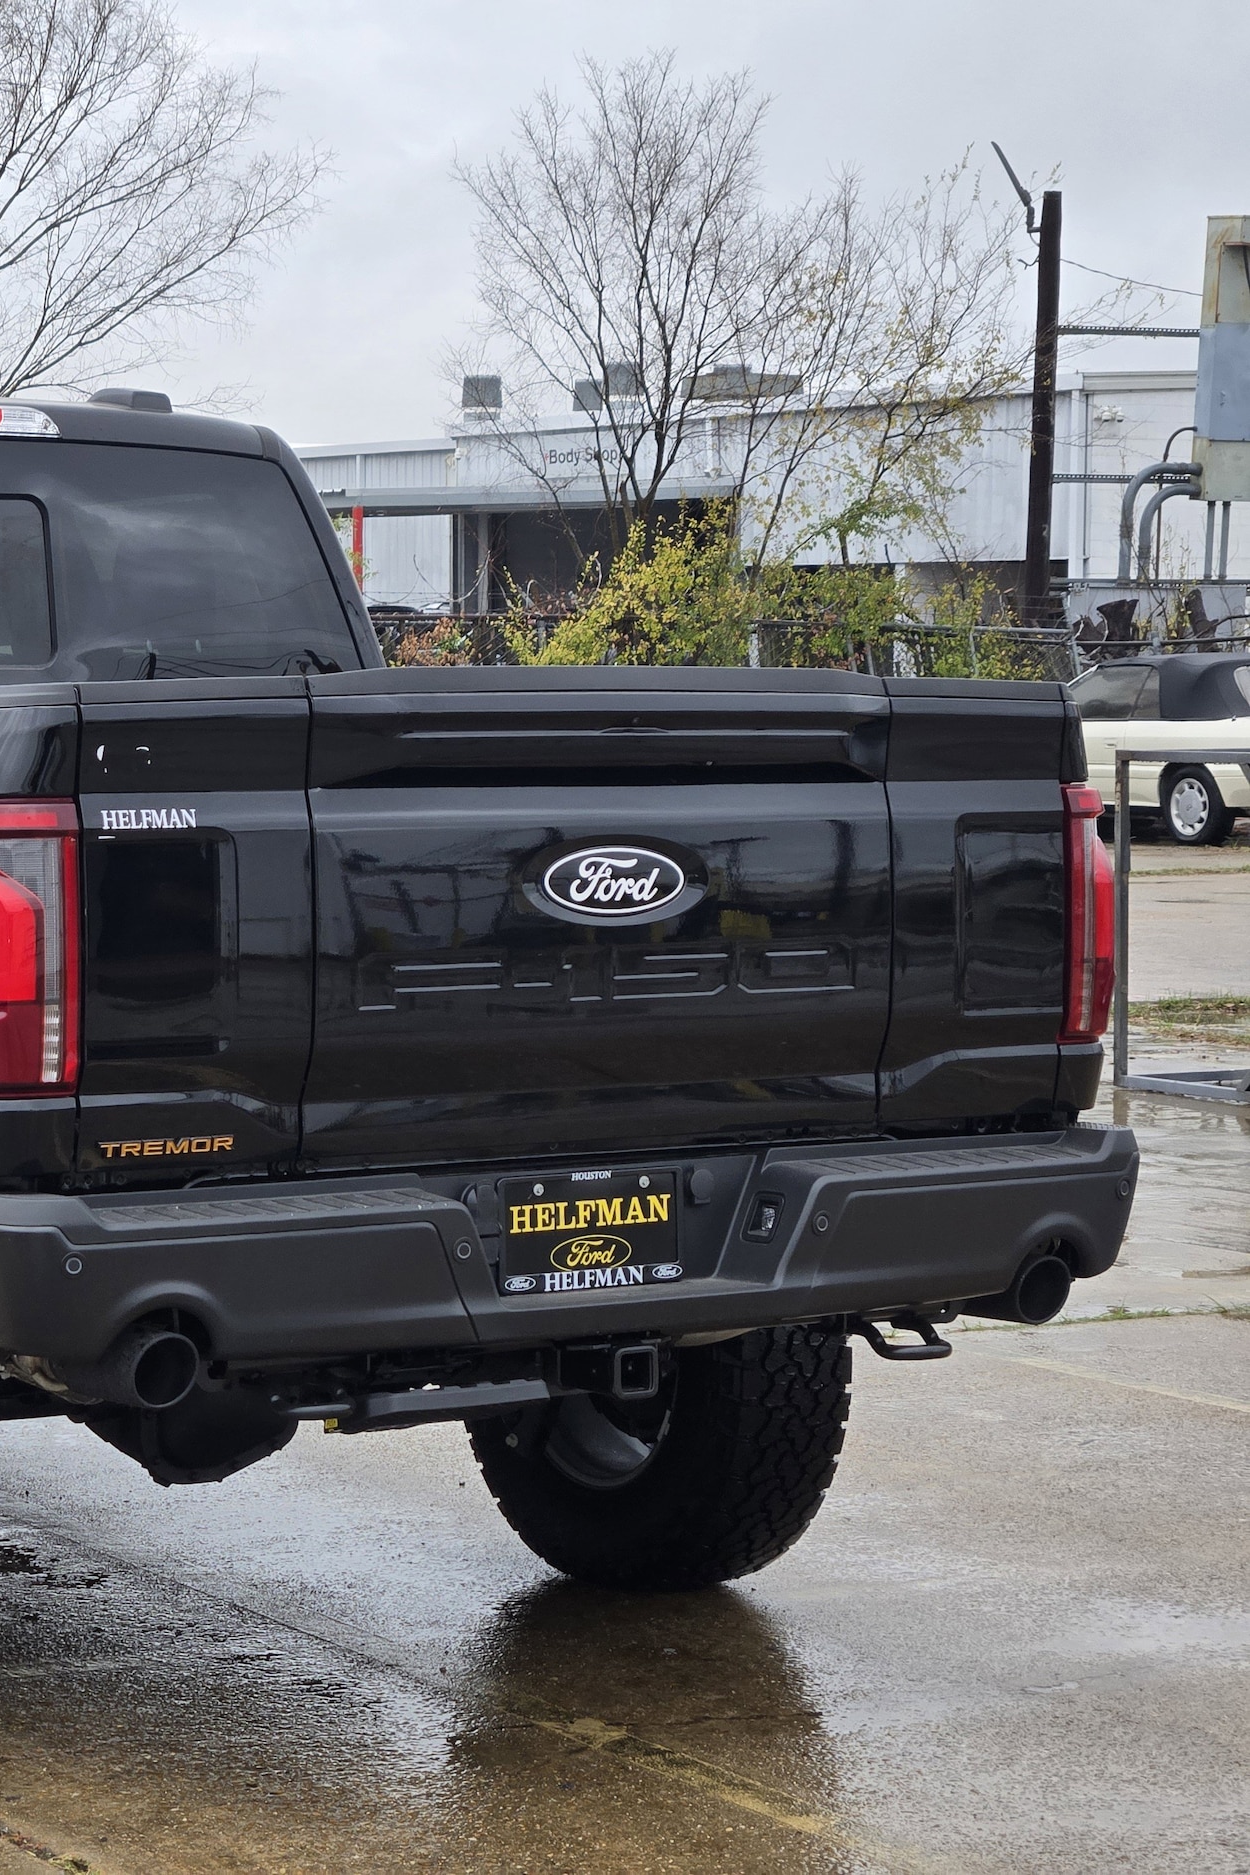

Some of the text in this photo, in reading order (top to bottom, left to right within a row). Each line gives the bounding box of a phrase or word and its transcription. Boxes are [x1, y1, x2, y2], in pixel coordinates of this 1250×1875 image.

[549, 448, 581, 466] Body
[101, 808, 197, 830] HELFMAN
[570, 856, 660, 902] Ford
[99, 1135, 235, 1158] TREMOR
[571, 1170, 613, 1182] HOUSTON
[509, 1193, 671, 1234] HELFMAN
[566, 1239, 616, 1267] Ford
[543, 1265, 645, 1292] HELFMAN
